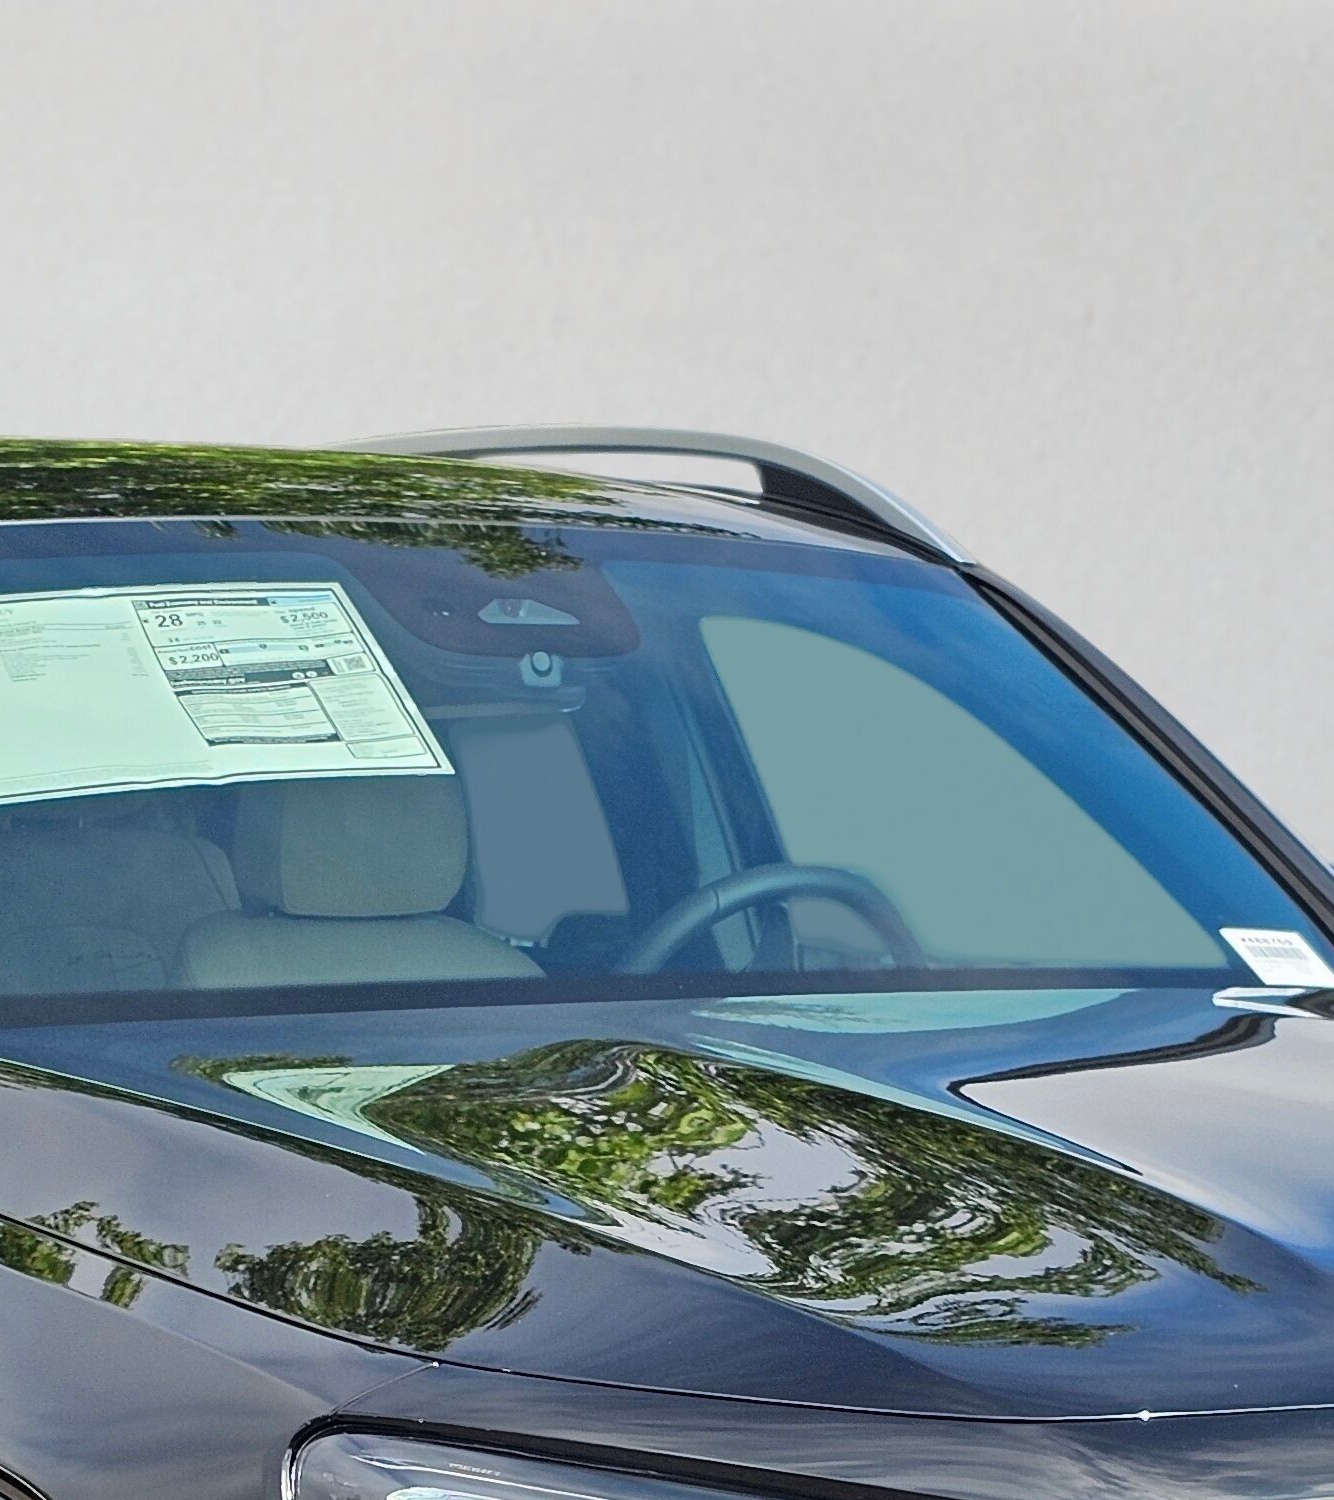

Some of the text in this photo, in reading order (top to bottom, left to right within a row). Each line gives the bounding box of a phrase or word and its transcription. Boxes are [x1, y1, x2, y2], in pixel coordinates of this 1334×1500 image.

[155, 613, 183, 628] 28
[279, 611, 329, 624] $2,500
[168, 653, 219, 666] $2,200
